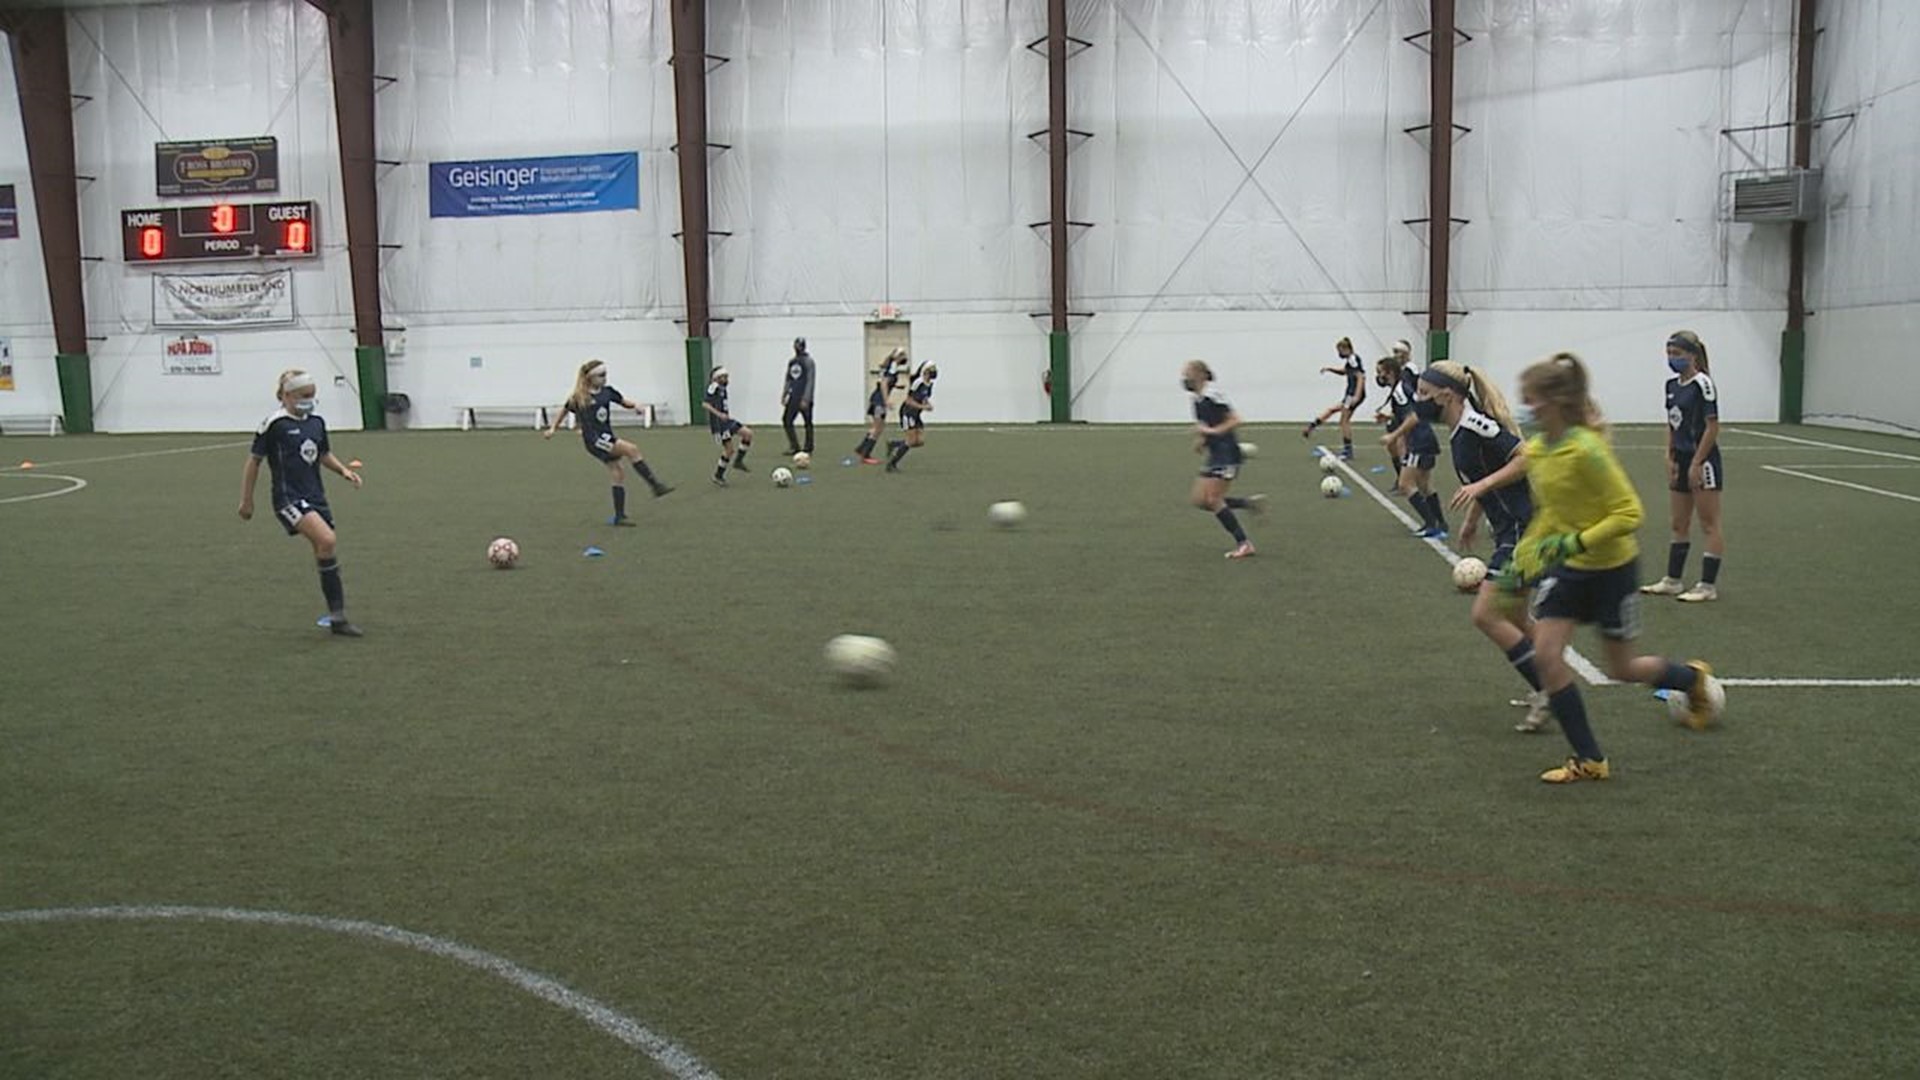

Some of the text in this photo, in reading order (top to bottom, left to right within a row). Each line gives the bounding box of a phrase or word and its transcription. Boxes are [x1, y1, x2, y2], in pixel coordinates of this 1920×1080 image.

[449, 165, 538, 191] Geisinger
[127, 213, 162, 227] HOME
[268, 206, 307, 220] GUEST
[143, 228, 162, 256] 0
[287, 221, 306, 249] 0
[204, 239, 239, 251] PERIOD
[167, 342, 186, 355] PAPA
